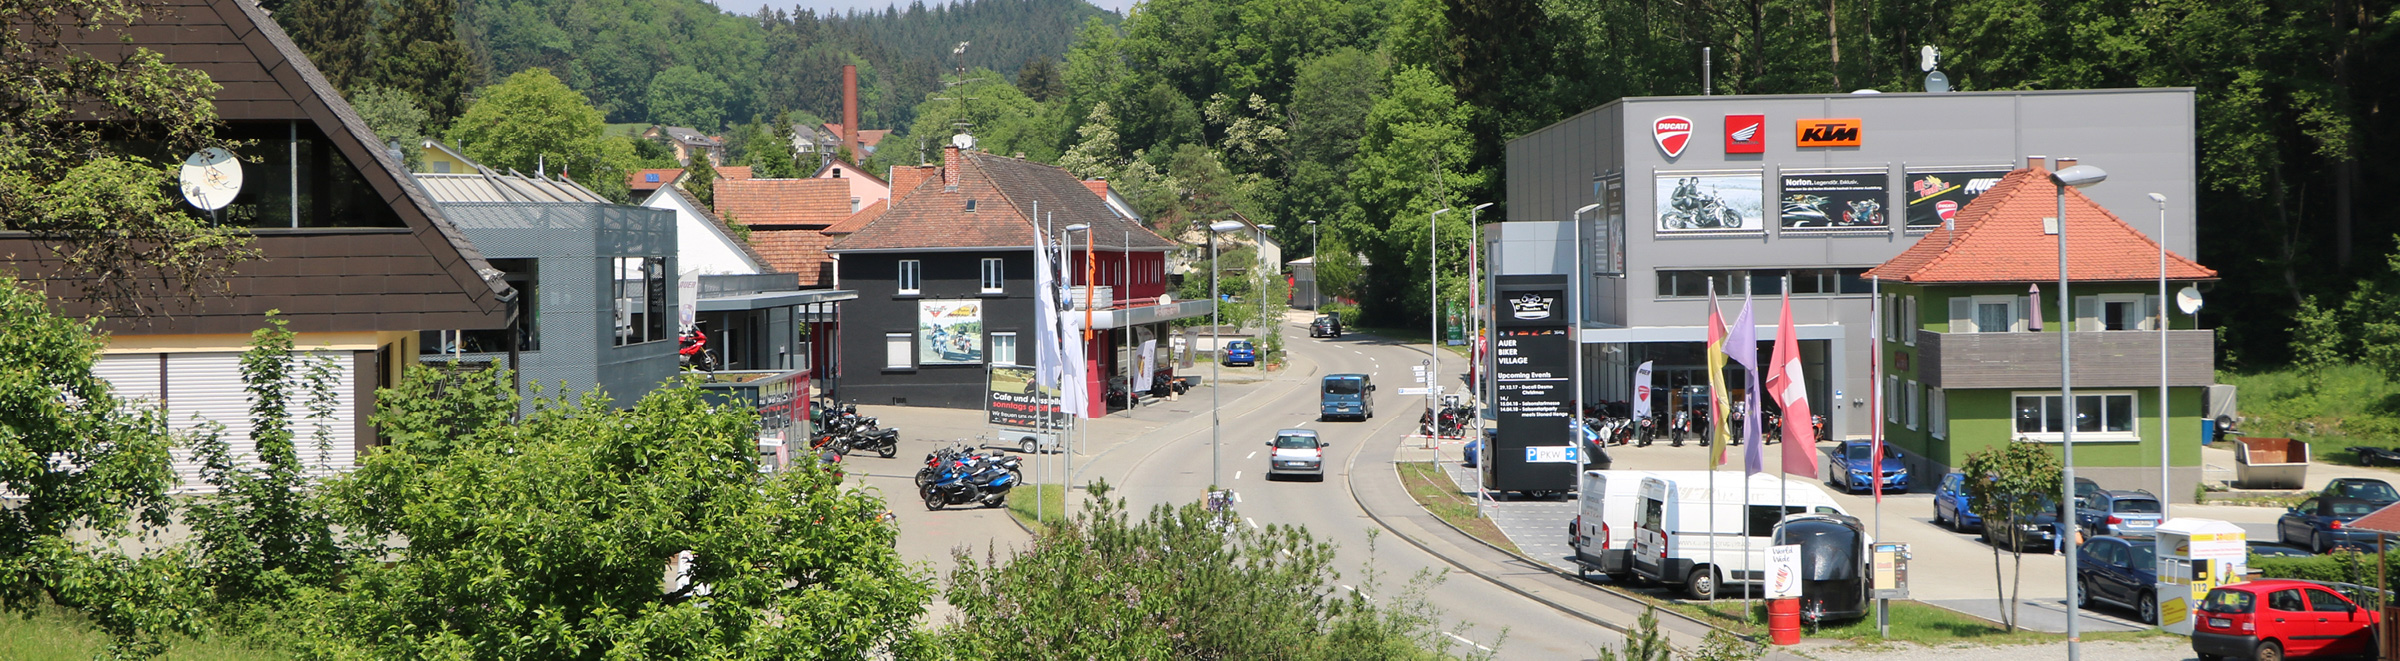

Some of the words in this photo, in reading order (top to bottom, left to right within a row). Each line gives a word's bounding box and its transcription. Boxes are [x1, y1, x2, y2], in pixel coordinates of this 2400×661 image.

[1658, 122, 1689, 130] DUCATI
[1801, 124, 1859, 142] KTM
[993, 392, 1012, 401] Cafe
[993, 401, 1027, 410] sonntags
[1540, 451, 1560, 459] PKW
[2193, 583, 2207, 592] 112
